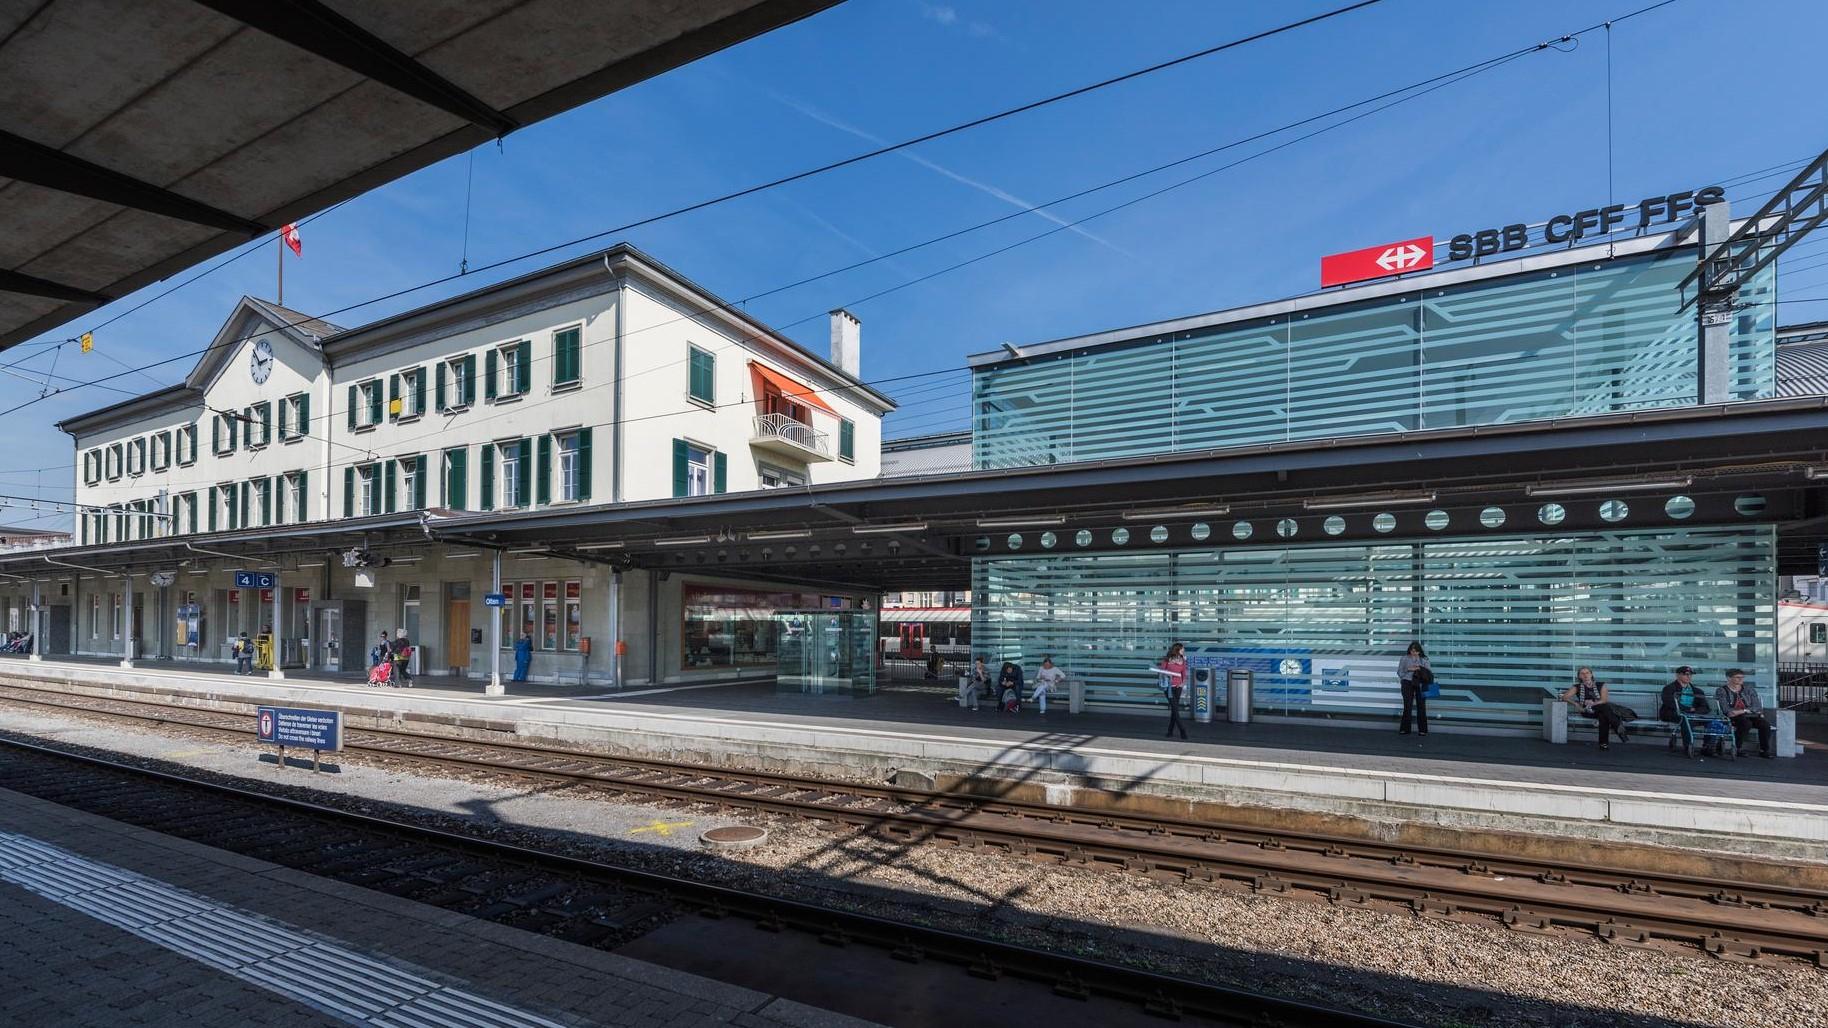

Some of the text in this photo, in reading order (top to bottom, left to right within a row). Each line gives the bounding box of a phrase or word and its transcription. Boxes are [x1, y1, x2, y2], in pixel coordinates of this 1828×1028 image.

[1448, 186, 1725, 260] SBB CFF FFS
[241, 576, 250, 585] 4
[261, 577, 270, 586] C
